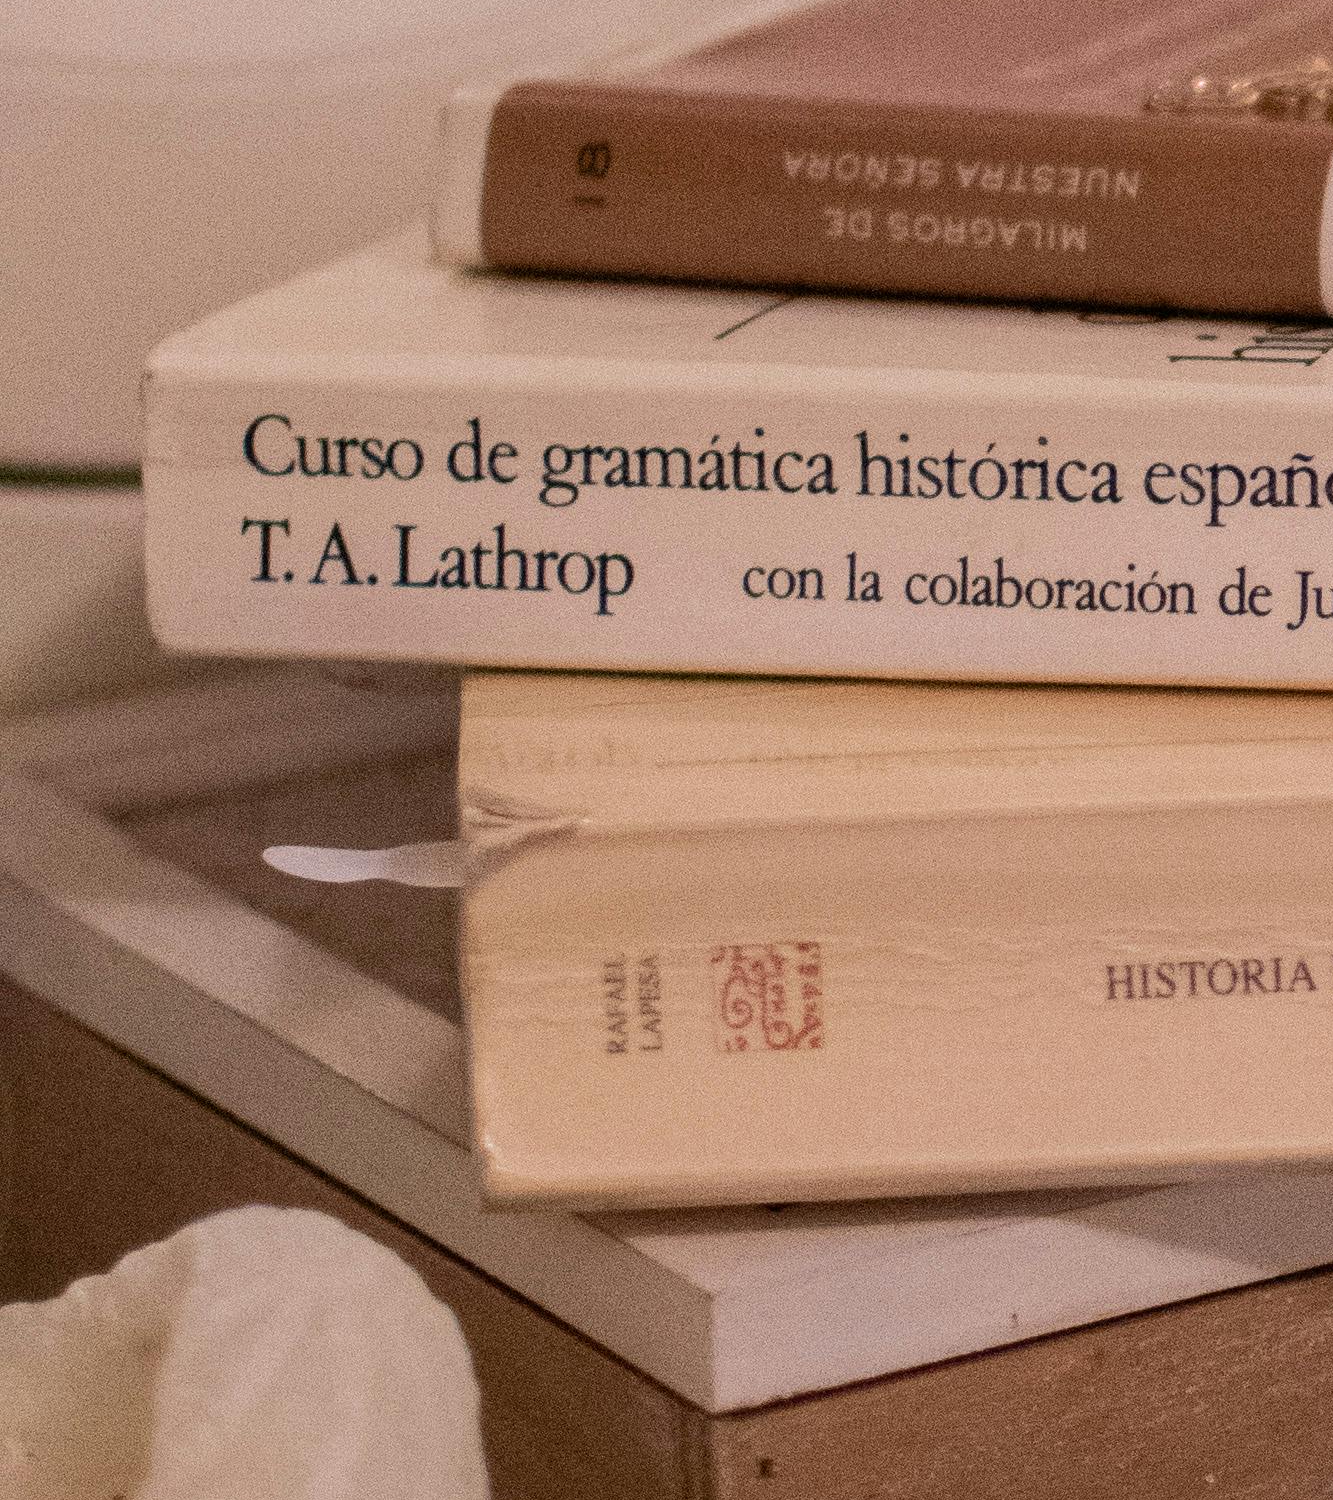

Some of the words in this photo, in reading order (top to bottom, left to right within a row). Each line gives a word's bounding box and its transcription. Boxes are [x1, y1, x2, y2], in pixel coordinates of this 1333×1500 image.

[825, 208, 873, 239] DE
[243, 414, 424, 479] Curso
[447, 418, 518, 484] de
[539, 428, 837, 507] gramática
[856, 431, 1122, 504] histórica
[242, 518, 293, 582] T.
[310, 523, 378, 585] A.
[394, 524, 634, 615] Lathrop
[743, 567, 824, 600] con
[847, 552, 882, 602] la
[905, 556, 1196, 614] colaboración
[1218, 566, 1272, 617] de
[1106, 957, 1316, 1000] HISTORIA
